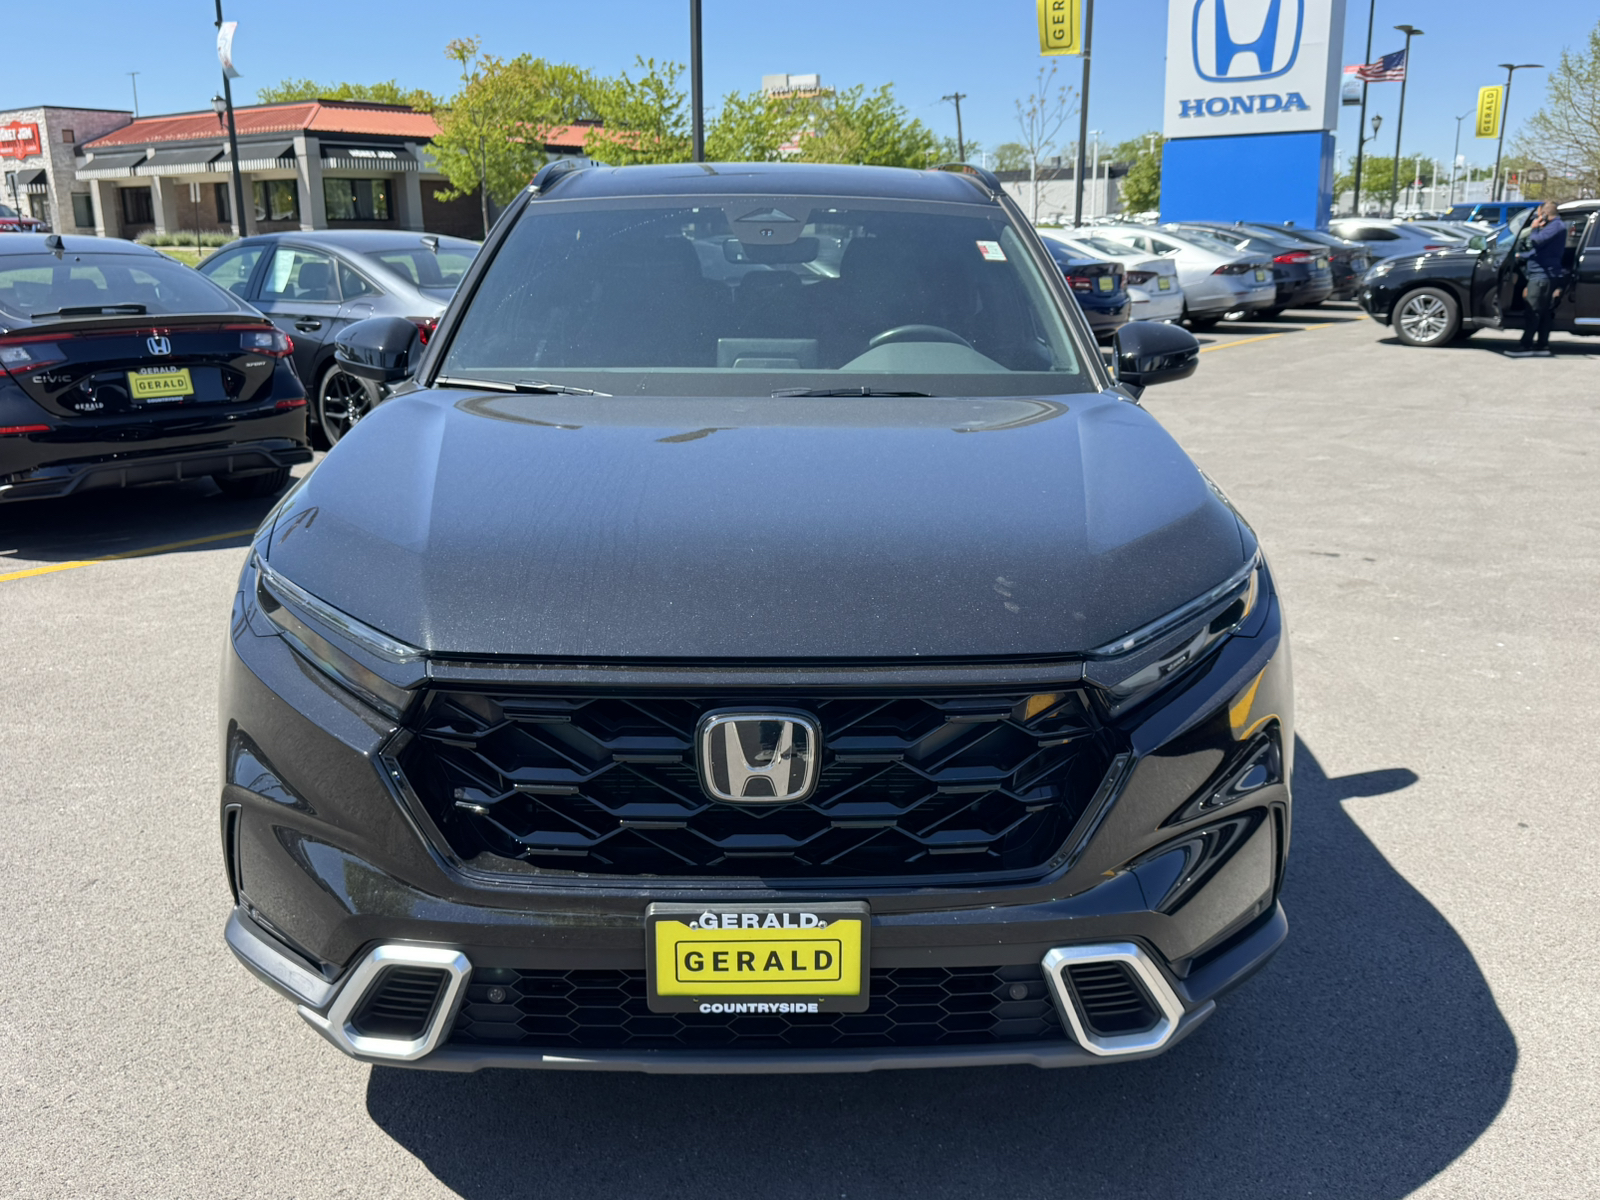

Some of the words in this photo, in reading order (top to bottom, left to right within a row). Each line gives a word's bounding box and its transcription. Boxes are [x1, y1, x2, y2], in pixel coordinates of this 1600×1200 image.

[1179, 92, 1310, 118] HONDA
[1483, 92, 1495, 132] GERALD
[140, 366, 177, 375] GERALD
[32, 375, 72, 383] CIVIC
[139, 379, 184, 390] GERALD
[75, 402, 104, 410] GERALD
[699, 913, 819, 929] GERALD
[684, 950, 833, 972] GERALD
[699, 1003, 819, 1014] COUNTRYSIDE
